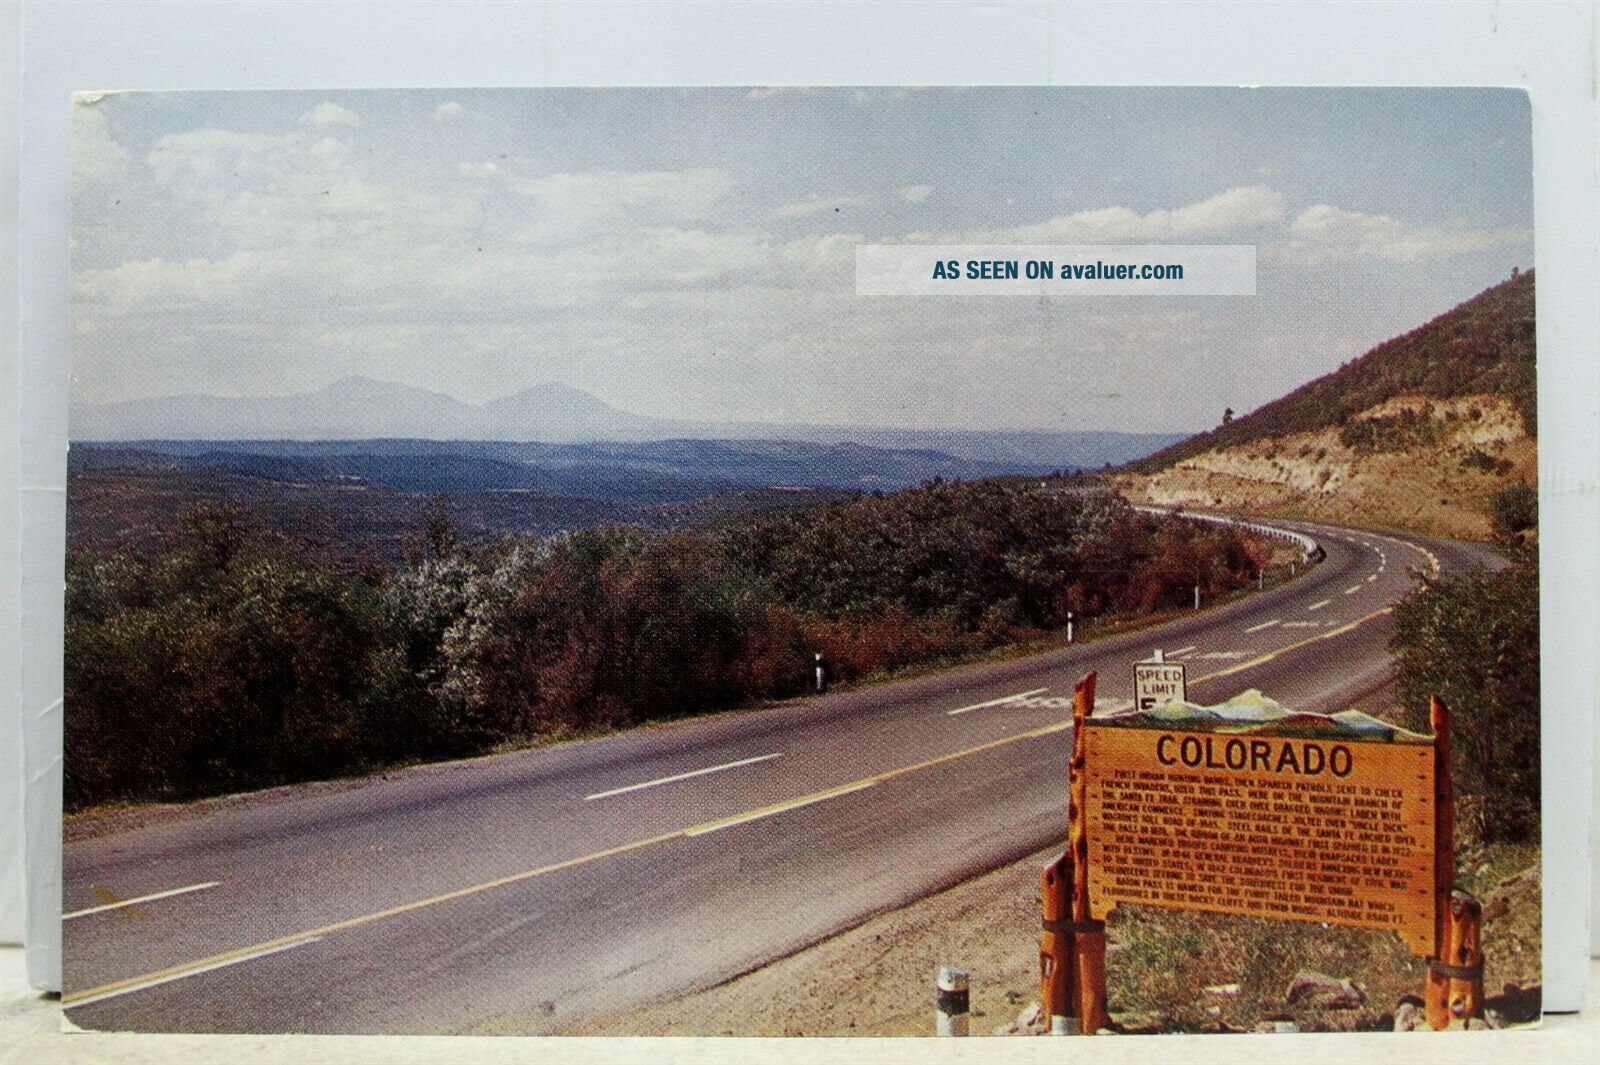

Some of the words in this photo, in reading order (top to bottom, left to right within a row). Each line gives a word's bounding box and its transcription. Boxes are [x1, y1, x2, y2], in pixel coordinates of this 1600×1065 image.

[1137, 669, 1182, 682] SPEED
[1143, 683, 1178, 695] LIMIT
[1156, 734, 1354, 778] COLORADO
